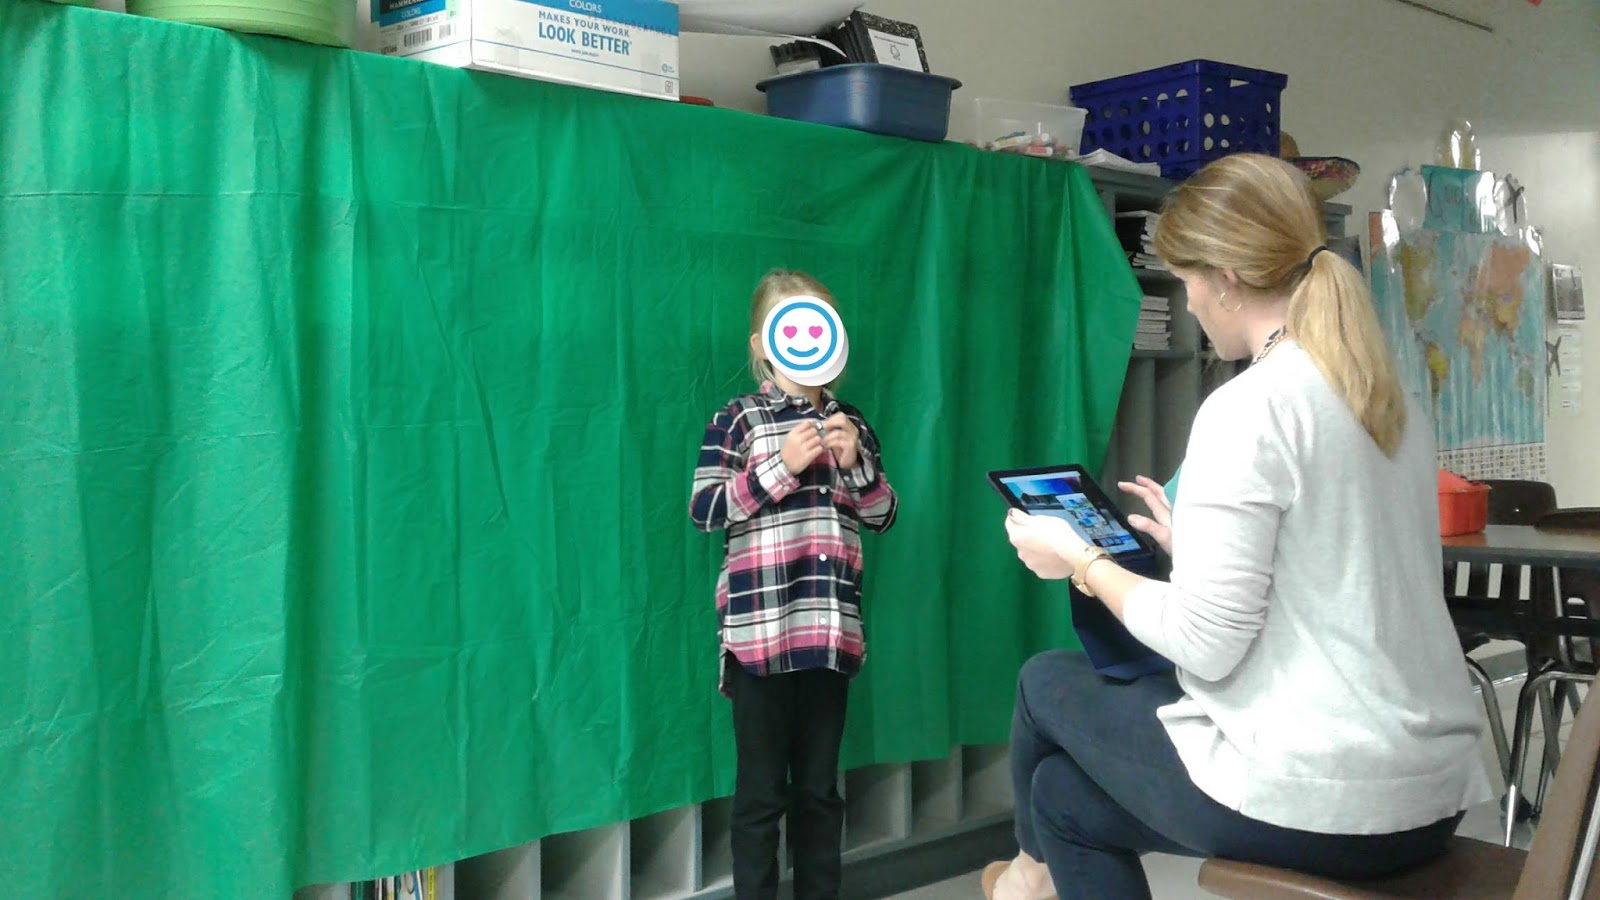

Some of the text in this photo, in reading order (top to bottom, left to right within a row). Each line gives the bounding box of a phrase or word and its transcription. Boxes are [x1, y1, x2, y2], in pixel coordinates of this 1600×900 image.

[401, 7, 422, 19] COLORS
[569, 0, 602, 14] COLORS
[538, 10, 571, 25] MAKES
[574, 18, 600, 31] YOUR
[602, 24, 630, 37] WORK
[538, 21, 576, 45] LOOK
[581, 31, 630, 56] BETTER
